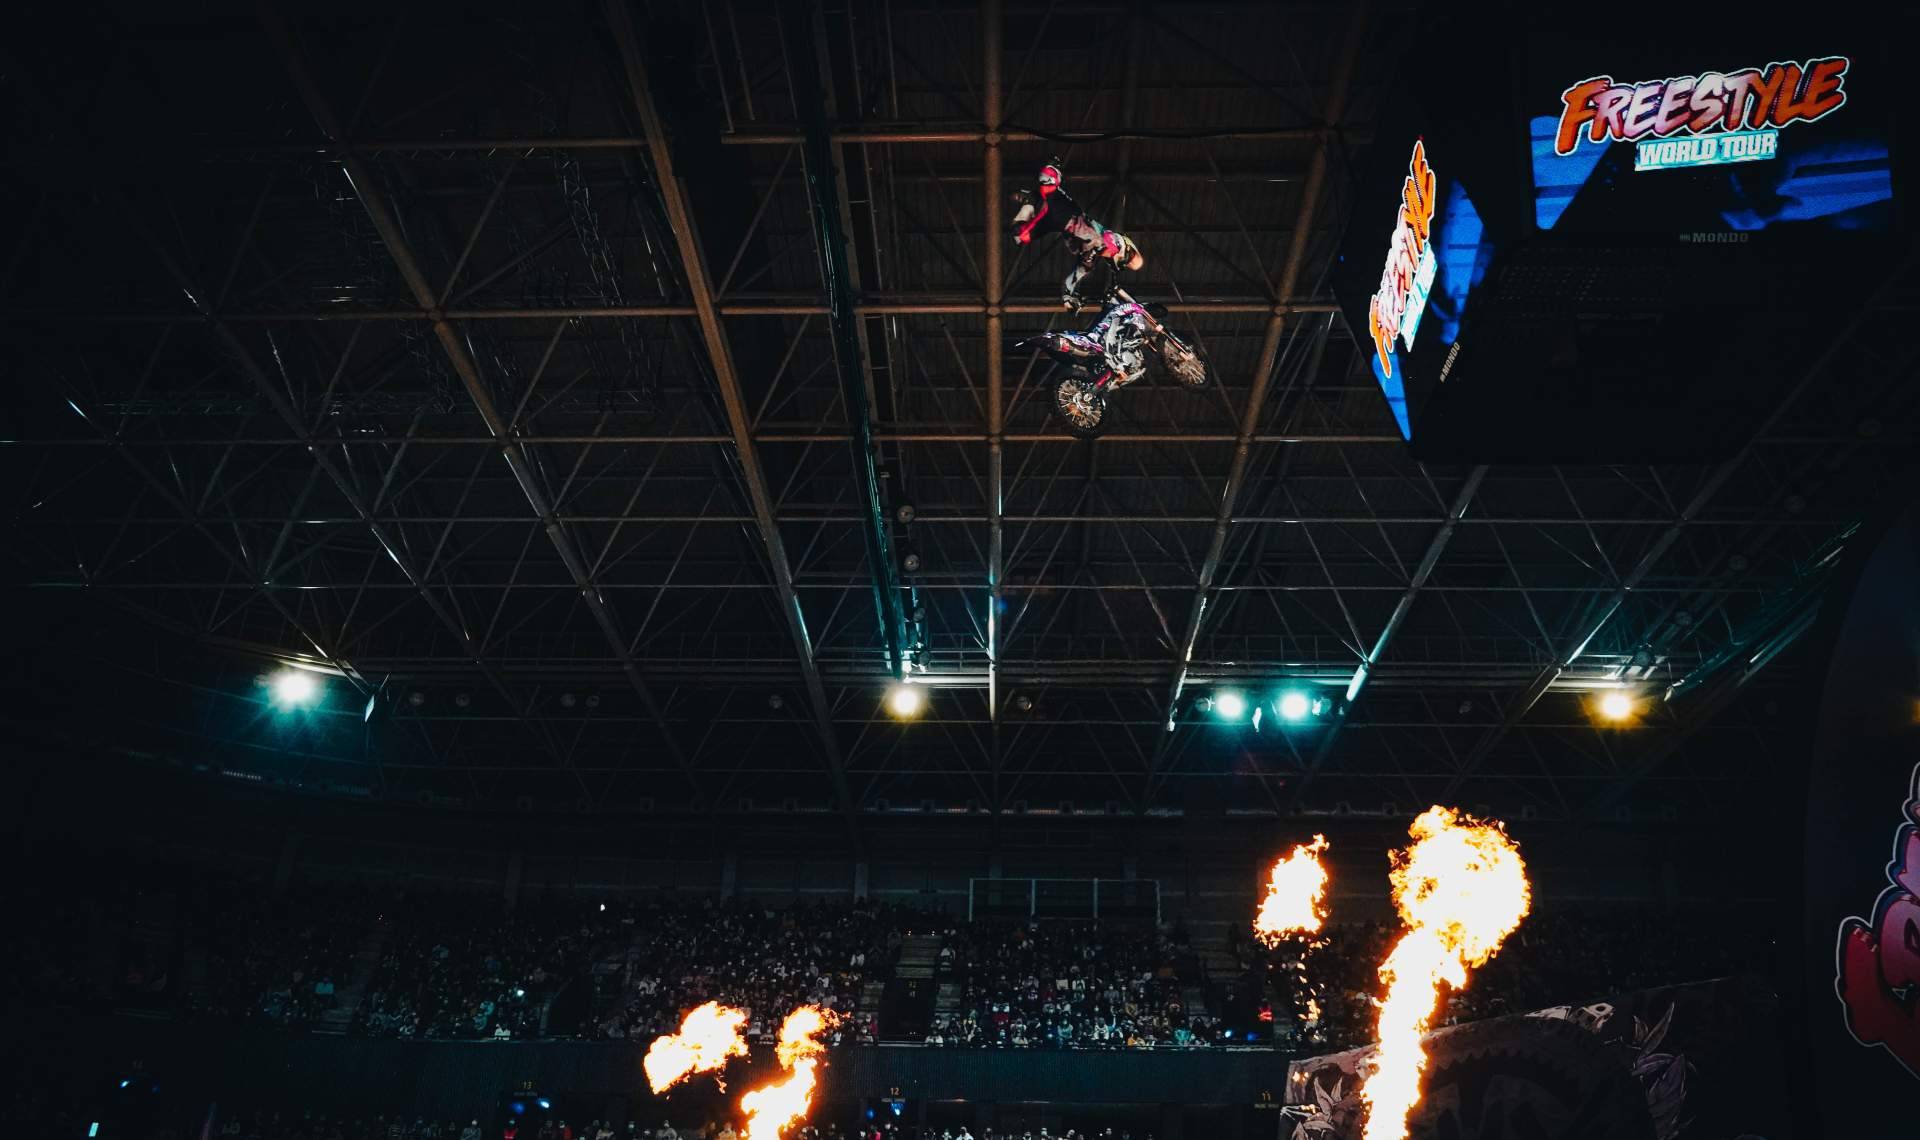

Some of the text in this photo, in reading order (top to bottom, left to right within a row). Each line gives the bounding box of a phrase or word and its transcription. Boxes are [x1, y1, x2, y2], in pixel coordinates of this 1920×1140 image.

[1556, 56, 1849, 155] FREESTYLE
[1639, 132, 1777, 166] WORLD TOUR
[1693, 231, 1749, 243] MONDO
[1442, 341, 1460, 376] MONDO
